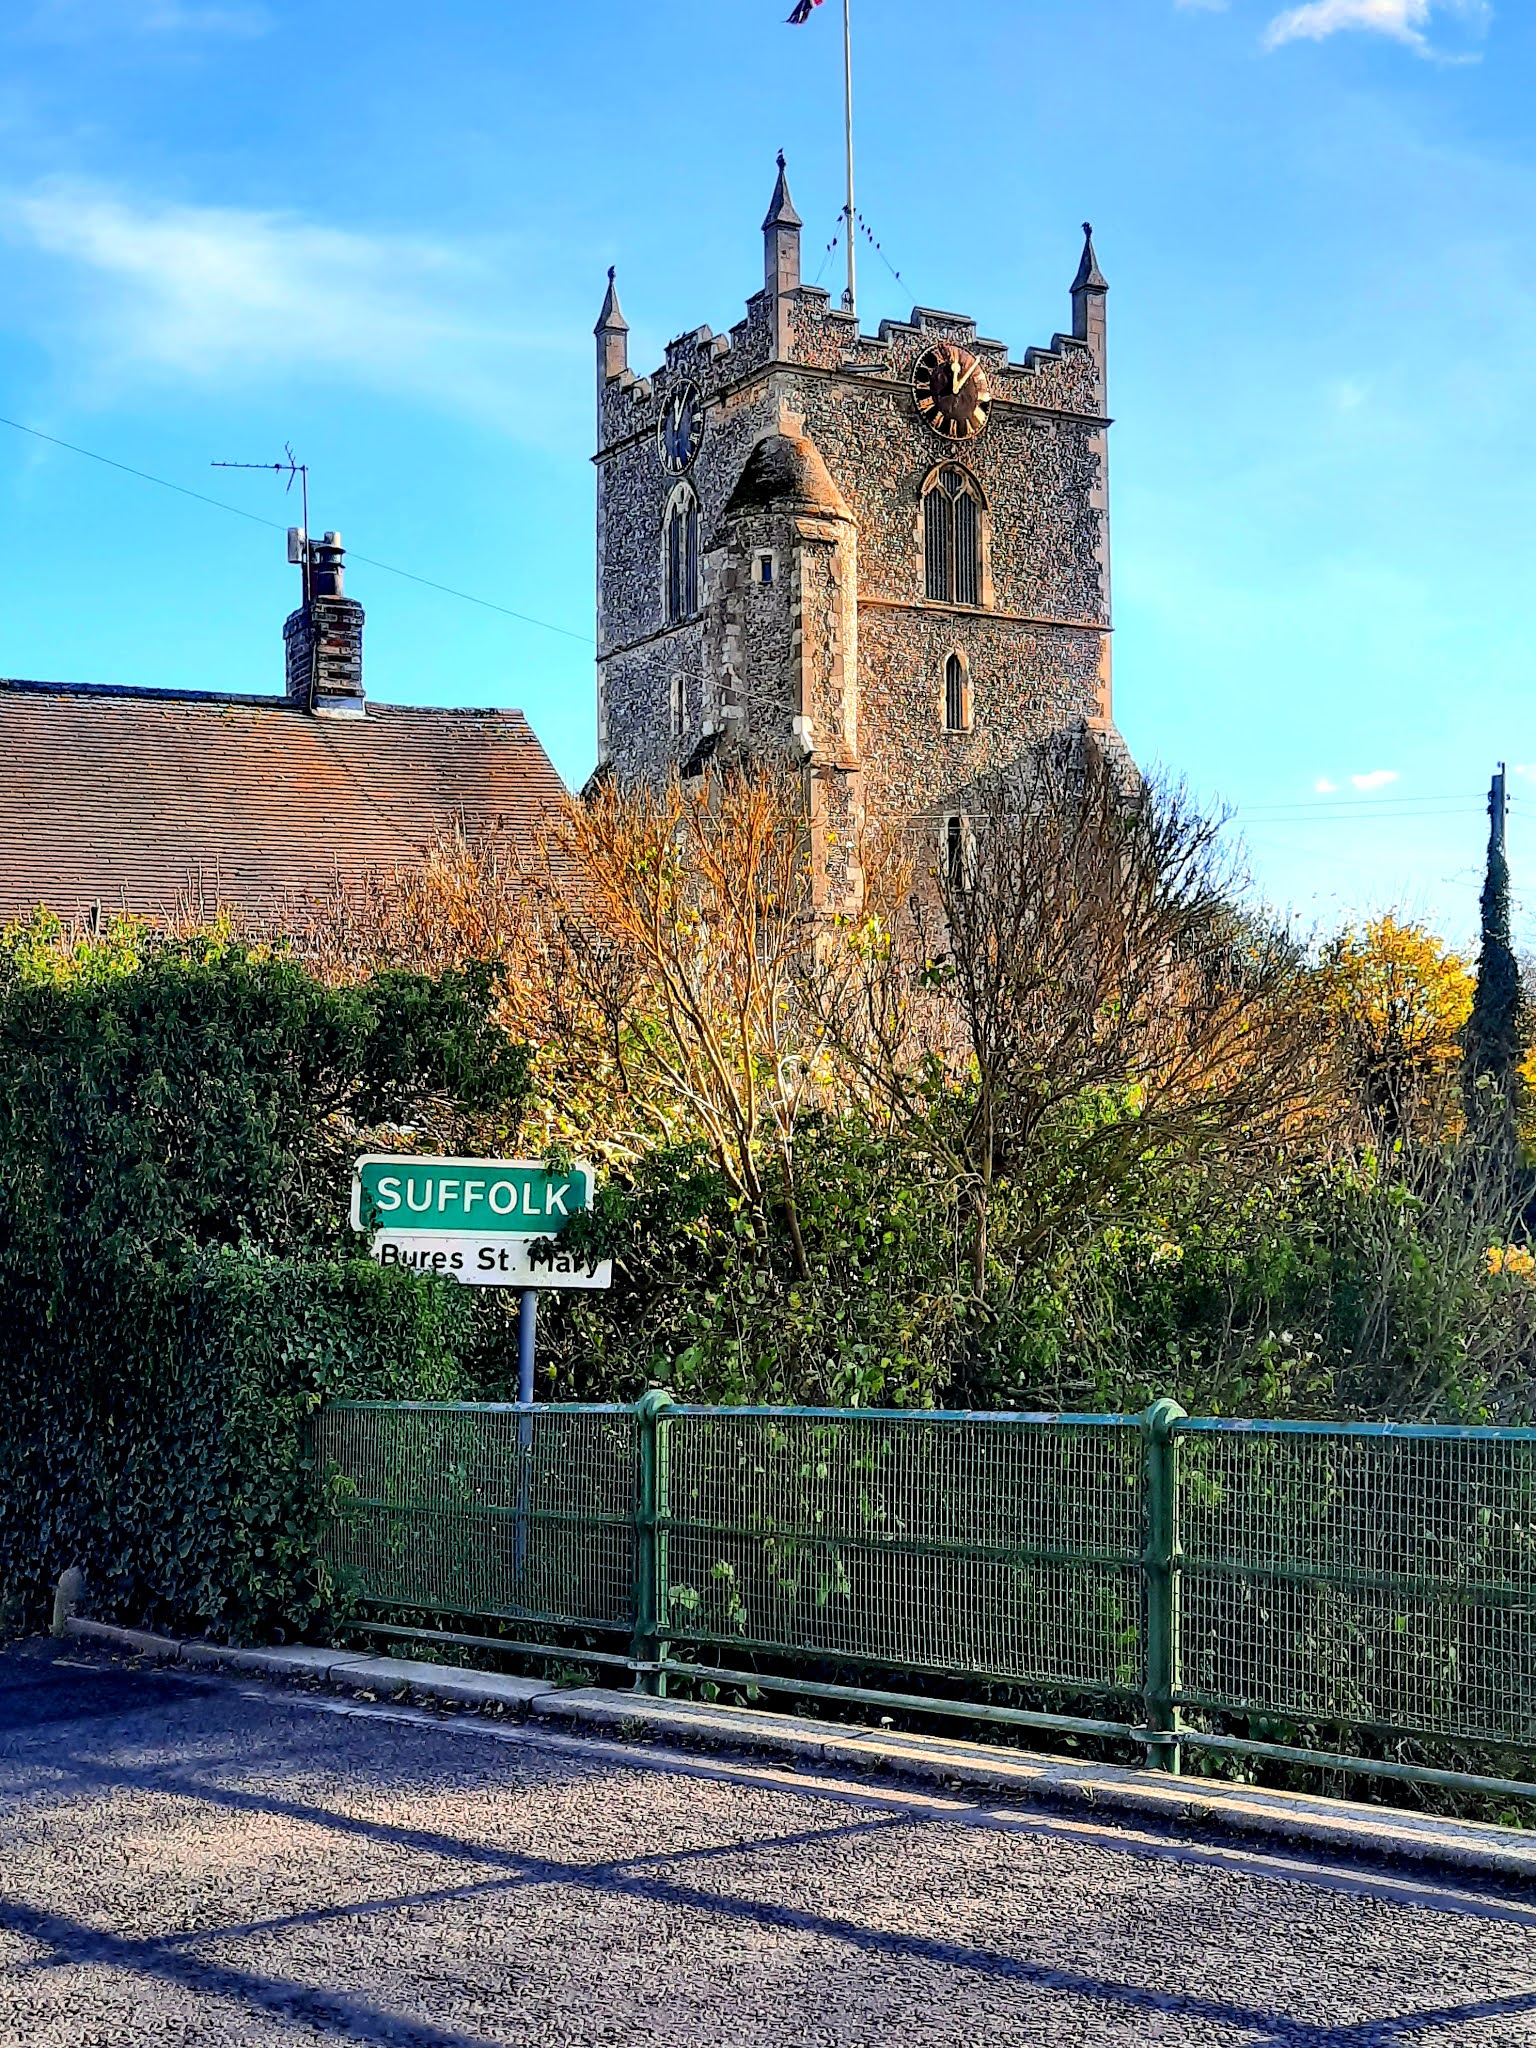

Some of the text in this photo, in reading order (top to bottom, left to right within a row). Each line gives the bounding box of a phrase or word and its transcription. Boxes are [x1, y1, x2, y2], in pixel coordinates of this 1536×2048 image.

[376, 1176, 572, 1215] SUFFOLK
[380, 1242, 599, 1278] Bures St. Mary
